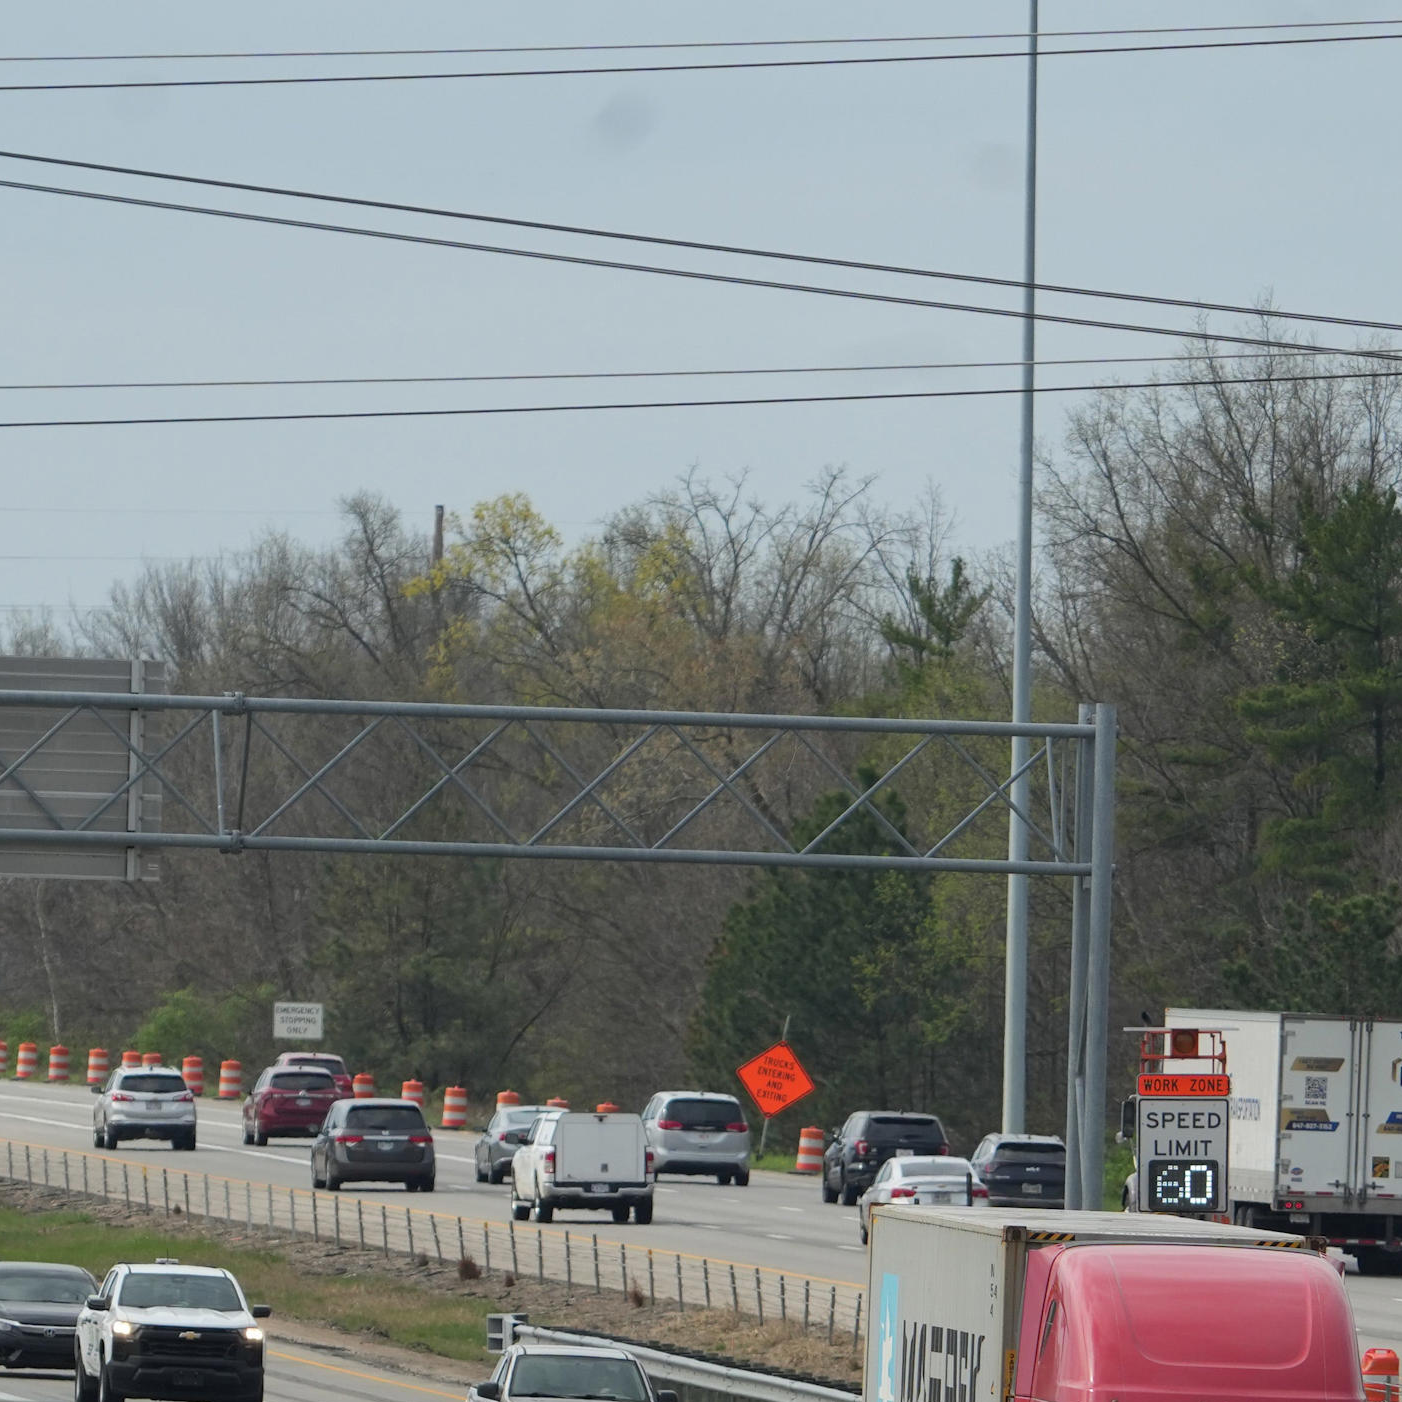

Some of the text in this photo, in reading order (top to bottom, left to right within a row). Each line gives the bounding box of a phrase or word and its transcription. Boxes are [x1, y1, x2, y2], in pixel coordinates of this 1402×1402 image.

[275, 1006, 319, 1015] EMERGENCY
[280, 1016, 317, 1025] STOPPING
[286, 1026, 308, 1034] ONLY
[764, 1056, 795, 1071] TRUCKS
[758, 1066, 796, 1082] ENTERING
[766, 1080, 783, 1091] AND
[1143, 1079, 1225, 1092] WORK ZONE
[756, 1089, 788, 1103] EXITING
[1146, 1112, 1222, 1129] SPEED
[1154, 1139, 1212, 1157] LIMIT
[1156, 1164, 1213, 1204] 60
